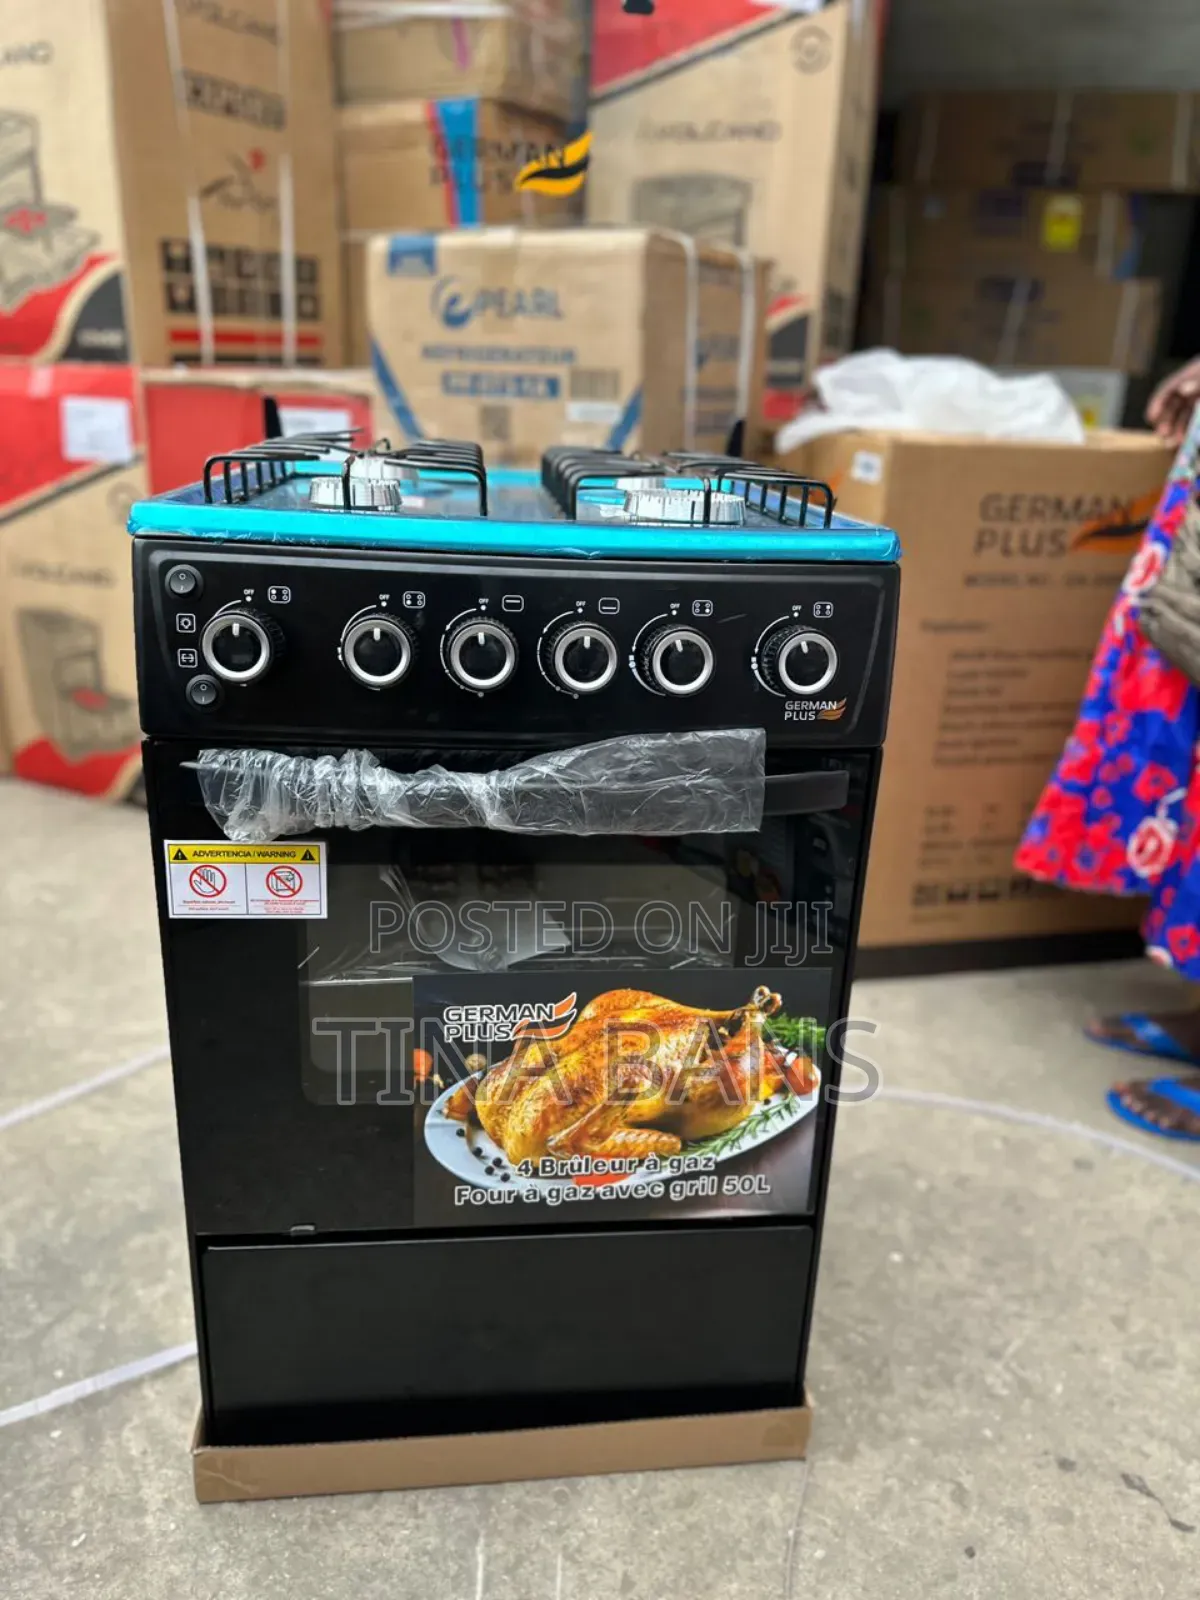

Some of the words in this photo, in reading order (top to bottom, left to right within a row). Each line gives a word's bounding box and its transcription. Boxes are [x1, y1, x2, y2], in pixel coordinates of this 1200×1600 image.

[979, 492, 1134, 523] GERMAN
[974, 526, 1069, 559] PLUS
[784, 700, 838, 711] GERMAN
[784, 711, 816, 721] PLUS
[192, 849, 251, 859] ADVERTENCIA
[257, 850, 297, 859] WARNING
[443, 1003, 556, 1024] GERMAN
[444, 1023, 513, 1042] PLUS
[516, 1158, 533, 1176] 4
[539, 1153, 639, 1176] Brûleur
[645, 1153, 660, 1172] à
[668, 1156, 716, 1175] gaz
[454, 1184, 518, 1206] Four
[523, 1180, 541, 1203] à
[547, 1182, 596, 1206] gaz
[599, 1178, 664, 1201] avec
[669, 1173, 716, 1200] gril
[722, 1172, 772, 1195] 50L
